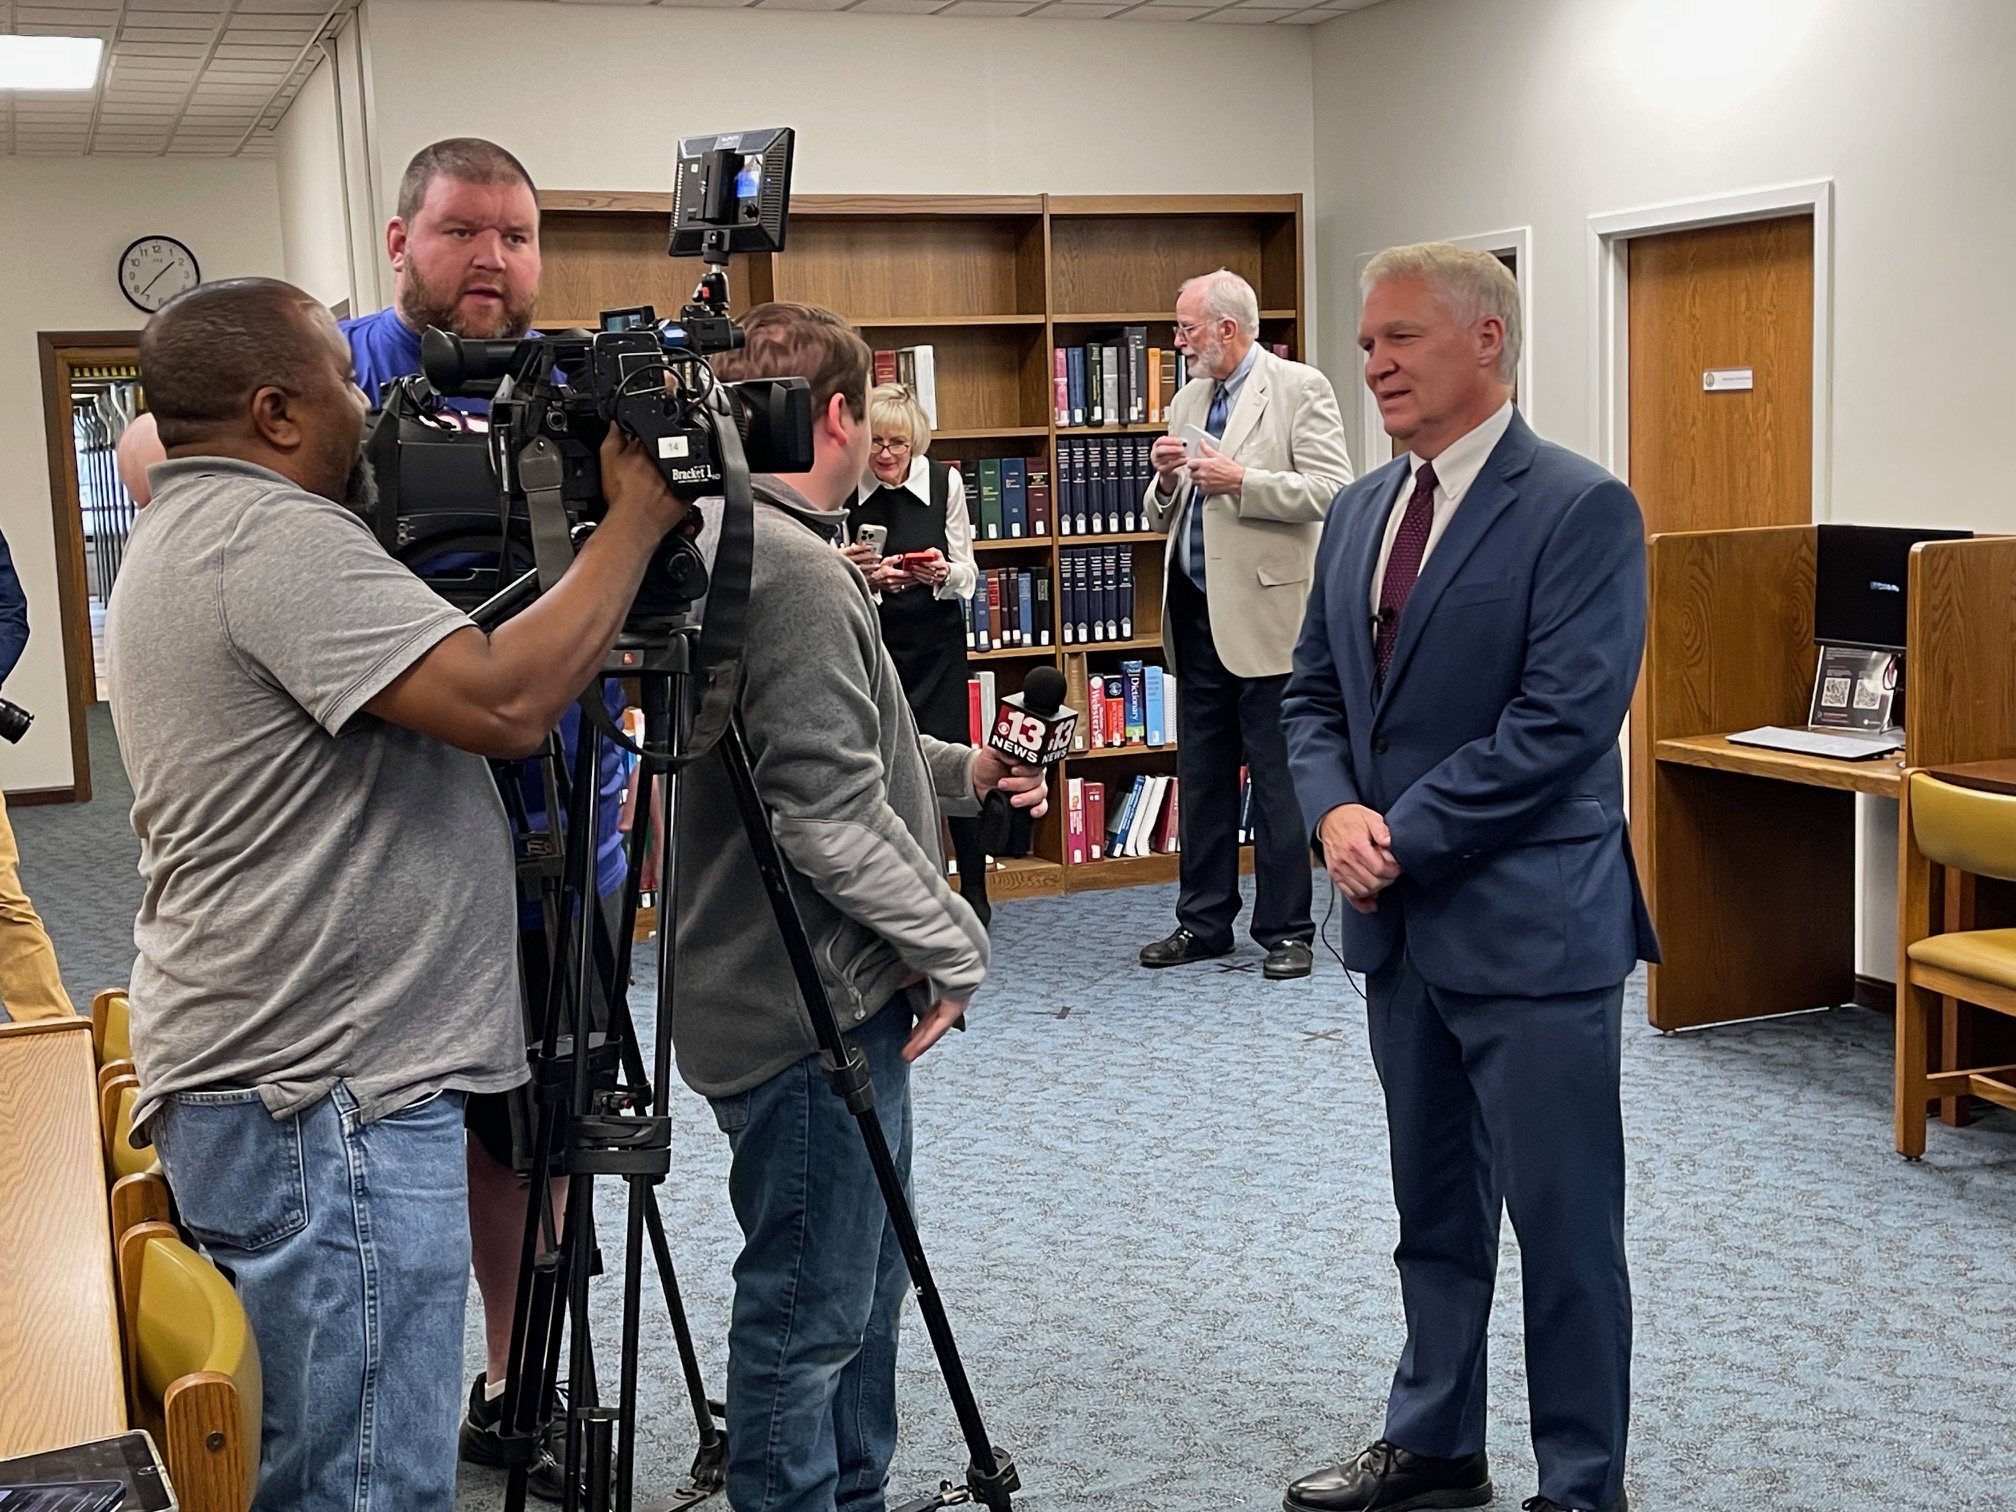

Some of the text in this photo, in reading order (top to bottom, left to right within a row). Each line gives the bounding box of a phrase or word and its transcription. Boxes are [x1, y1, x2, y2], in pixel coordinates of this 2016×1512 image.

[140, 248, 148, 257] 11
[152, 245, 161, 253] 12
[131, 258, 139, 267] 10
[178, 258, 184, 266] 2
[129, 271, 135, 280] 9
[184, 271, 190, 279] 3
[134, 285, 139, 293] 8
[668, 443, 679, 451] 14
[671, 467, 705, 480] Bracket
[1131, 678, 1140, 720] Dictionary
[1007, 711, 1046, 751] 13
[1052, 718, 1075, 750] 13
[991, 735, 1038, 763] NEWS
[1042, 747, 1067, 765] NEWS
